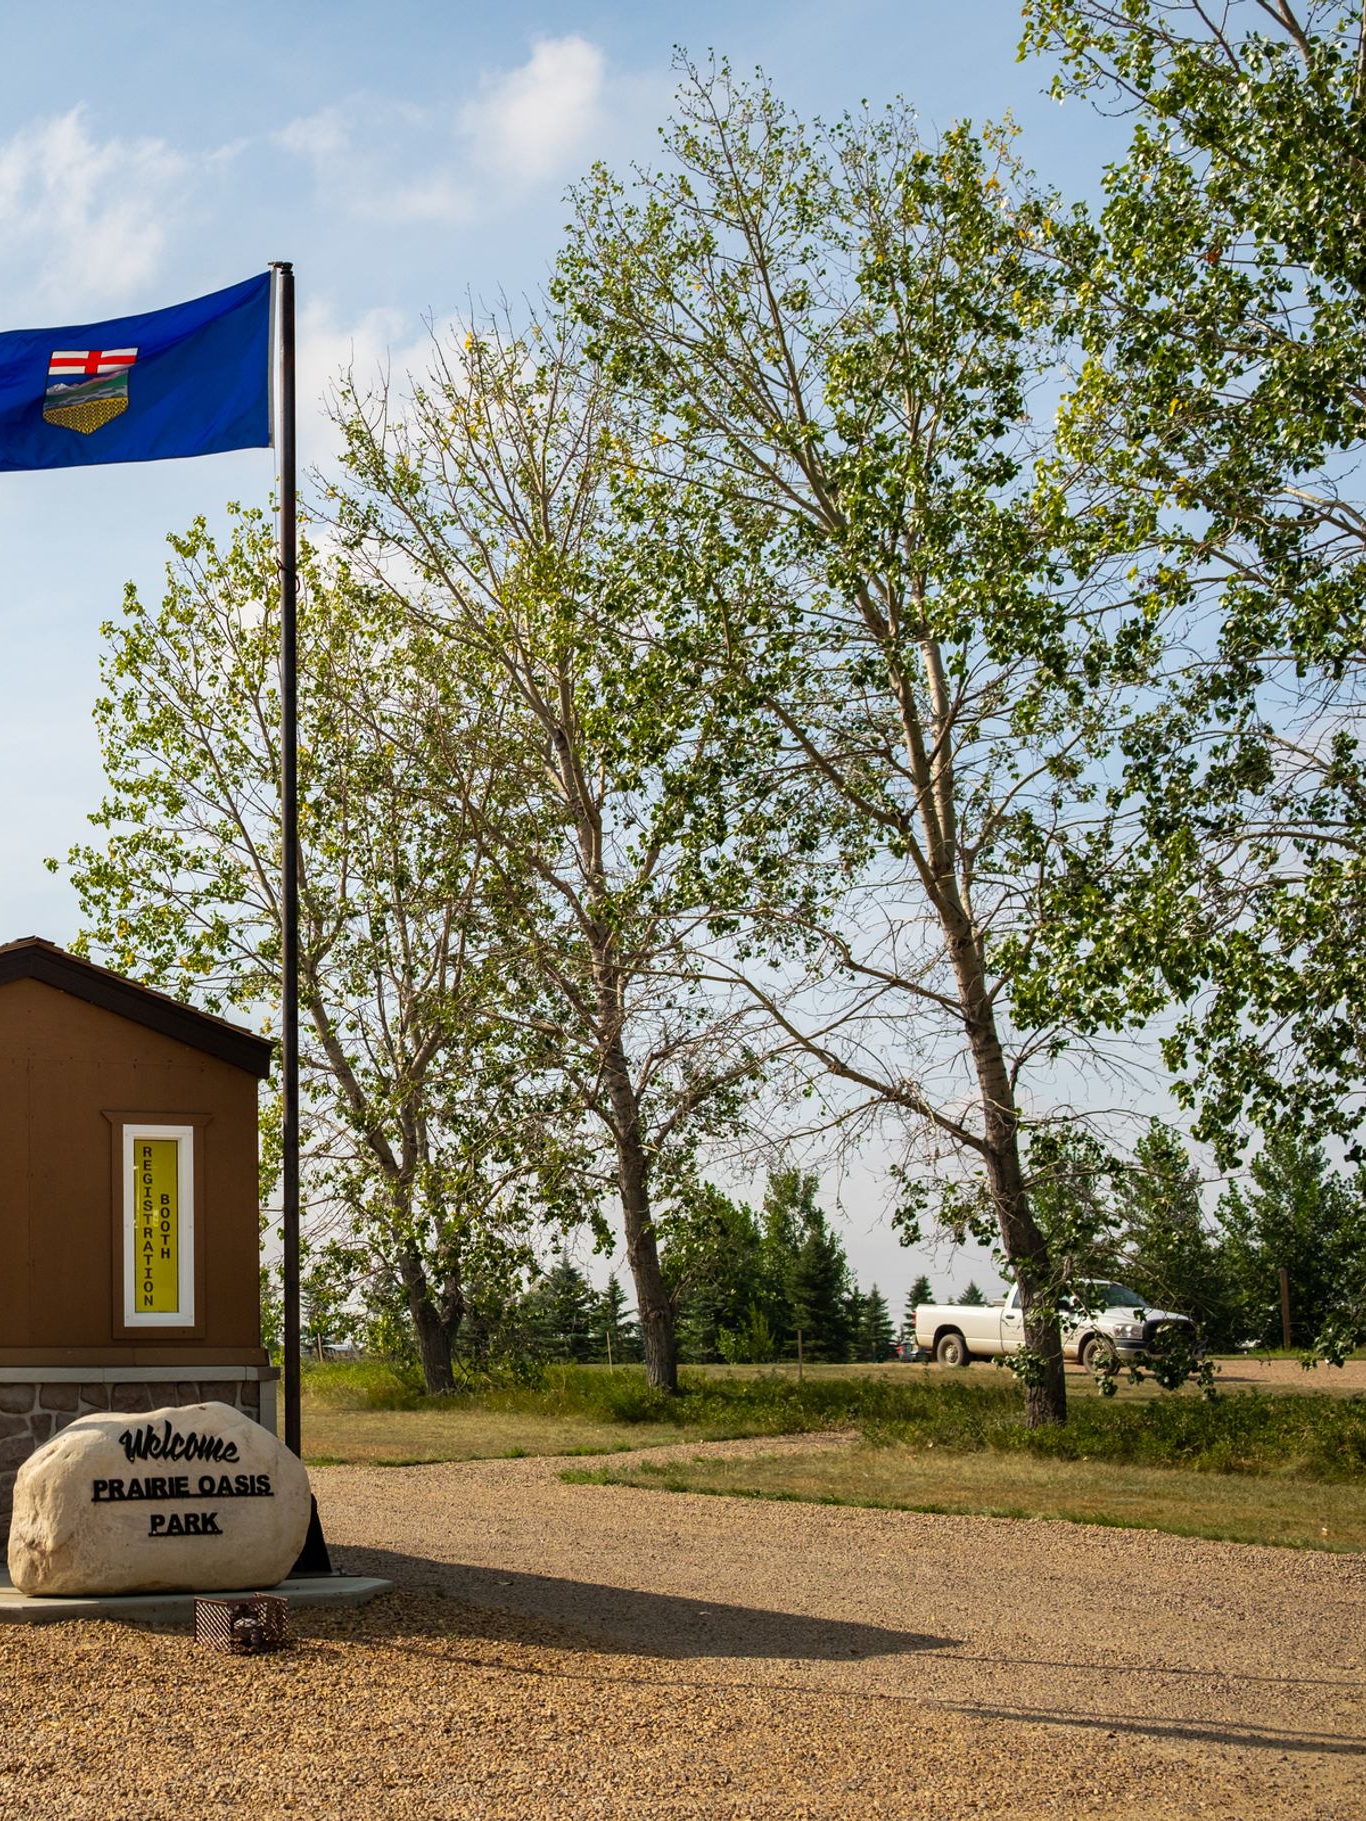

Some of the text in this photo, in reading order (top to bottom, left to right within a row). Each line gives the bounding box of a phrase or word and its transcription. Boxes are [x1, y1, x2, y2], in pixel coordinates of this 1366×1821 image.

[142, 1146, 154, 1306] REGISTRATION
[160, 1193, 171, 1259] BOOTH
[118, 1420, 240, 1463] Welcome
[92, 1474, 272, 1500] PRAIRIE OASIS
[150, 1512, 220, 1535] PARK
